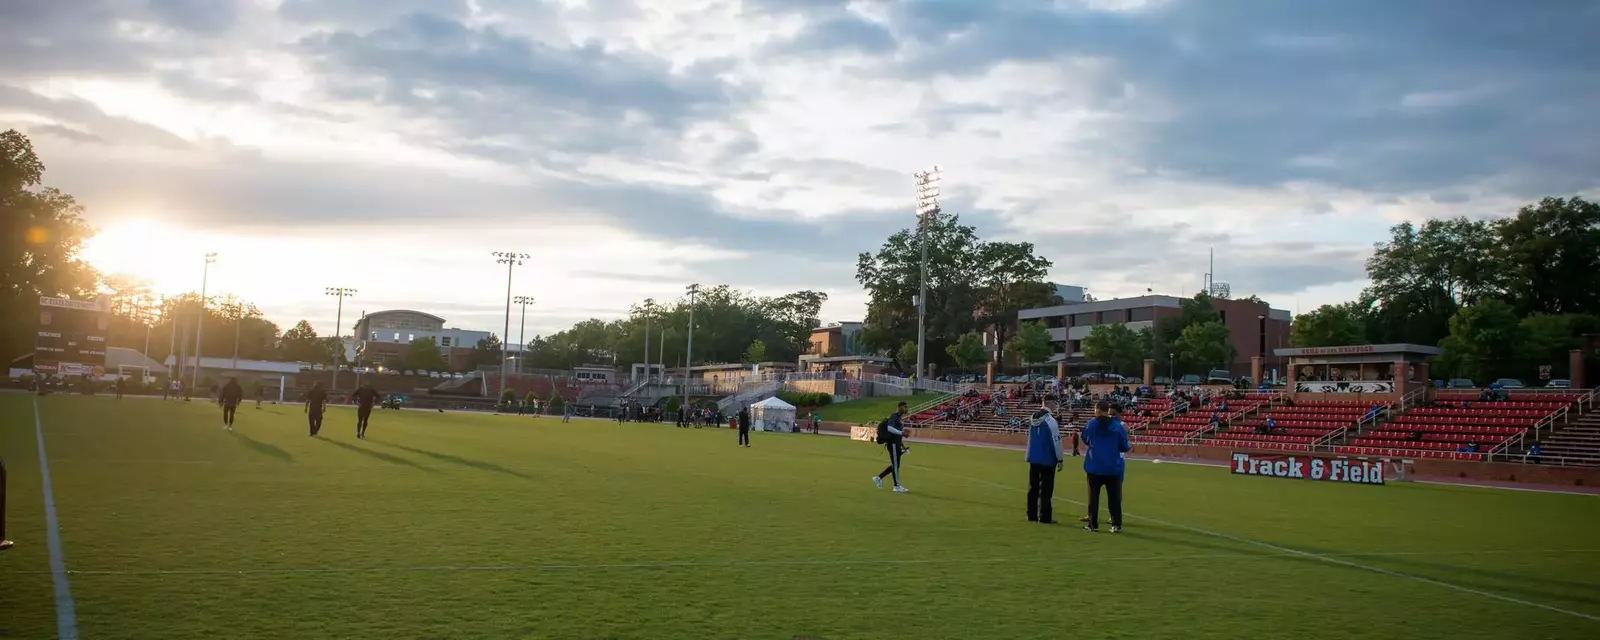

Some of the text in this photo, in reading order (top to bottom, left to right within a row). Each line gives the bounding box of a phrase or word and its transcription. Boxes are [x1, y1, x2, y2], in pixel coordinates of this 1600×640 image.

[1233, 453, 1383, 484] Track & Field
